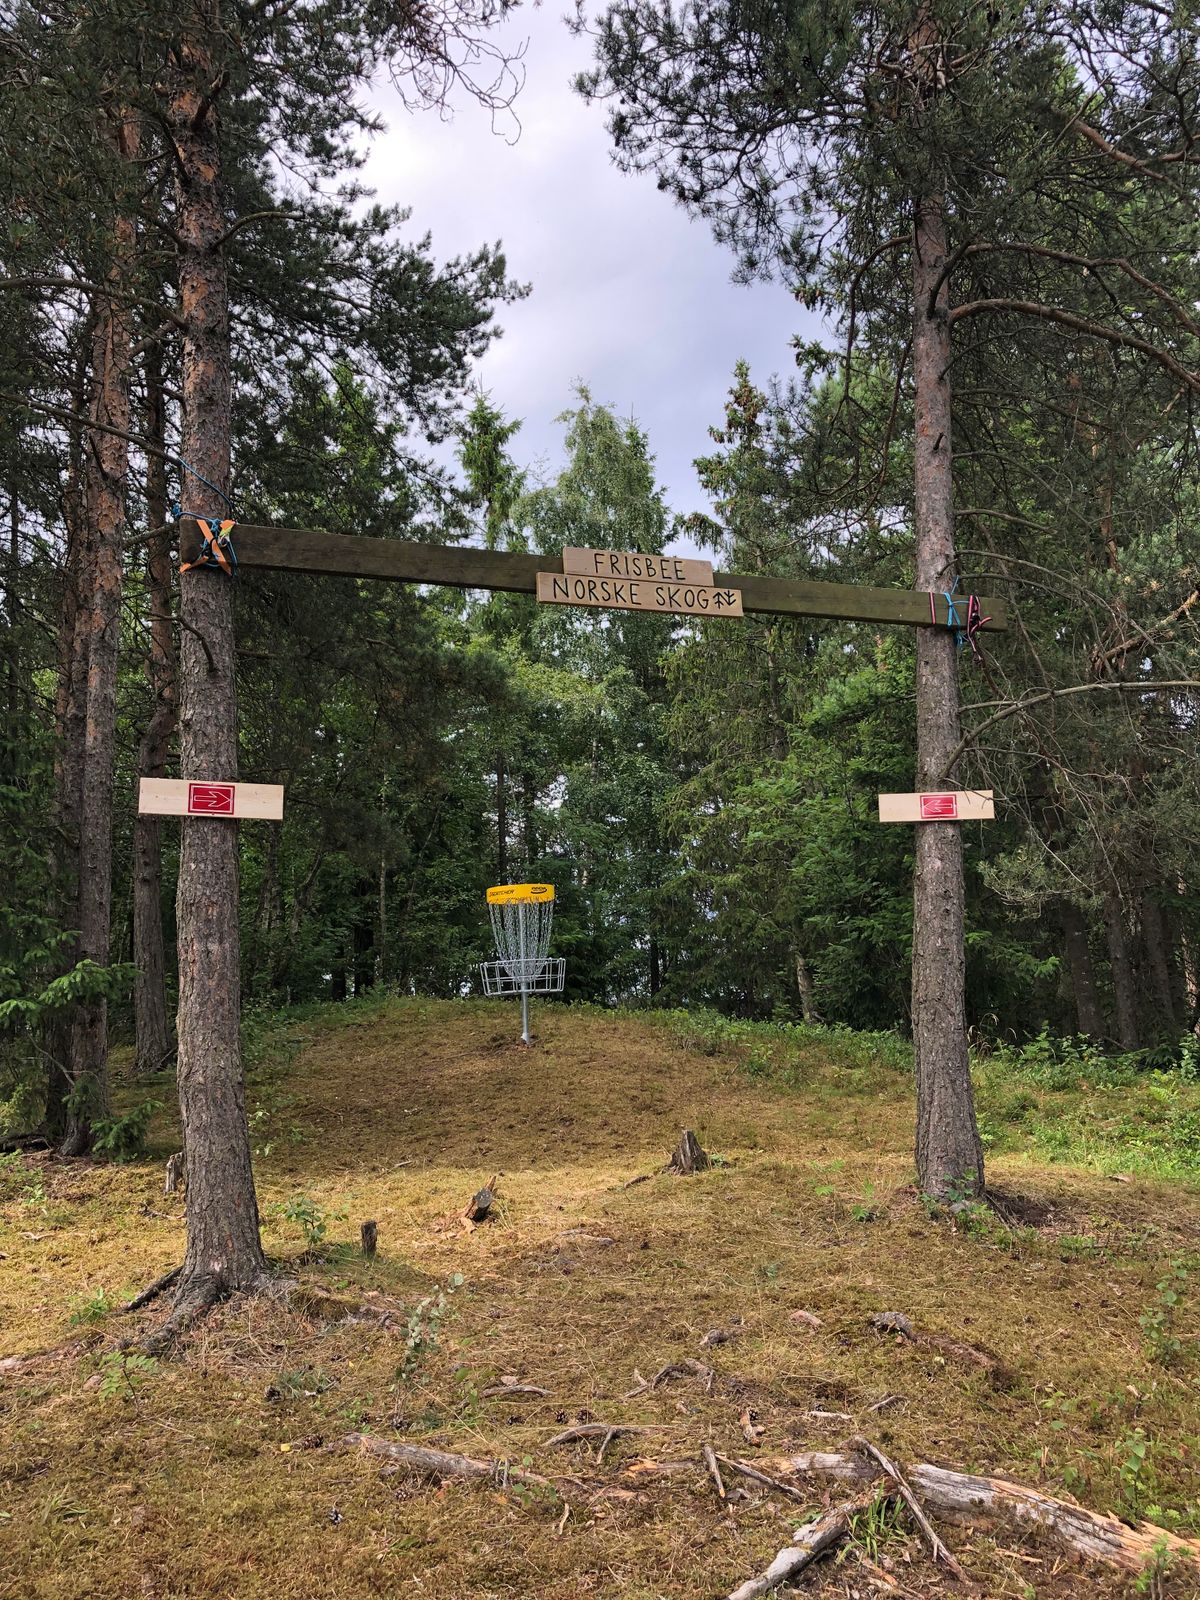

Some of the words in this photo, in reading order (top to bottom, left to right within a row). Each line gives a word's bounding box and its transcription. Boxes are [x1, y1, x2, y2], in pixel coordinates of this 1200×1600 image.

[593, 552, 687, 581] FRISBEE
[552, 577, 642, 606] NORSKE
[655, 586, 709, 610] SKOG
